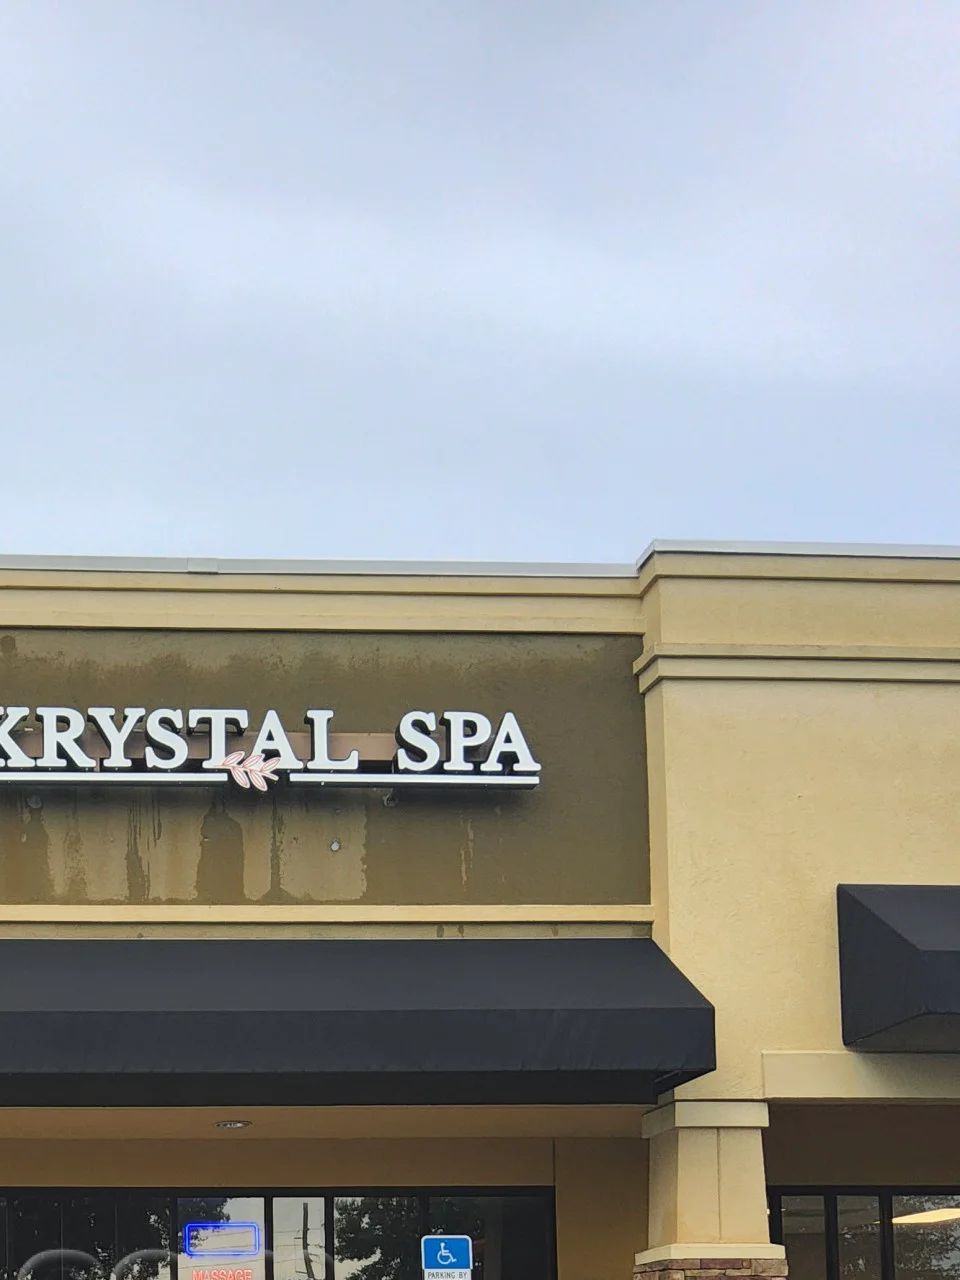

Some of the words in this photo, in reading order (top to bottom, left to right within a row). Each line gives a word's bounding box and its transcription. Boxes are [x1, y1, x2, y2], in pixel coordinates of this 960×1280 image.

[397, 711, 541, 772] SPA
[427, 1271, 456, 1279] PARKING
[458, 1271, 468, 1279] BY
